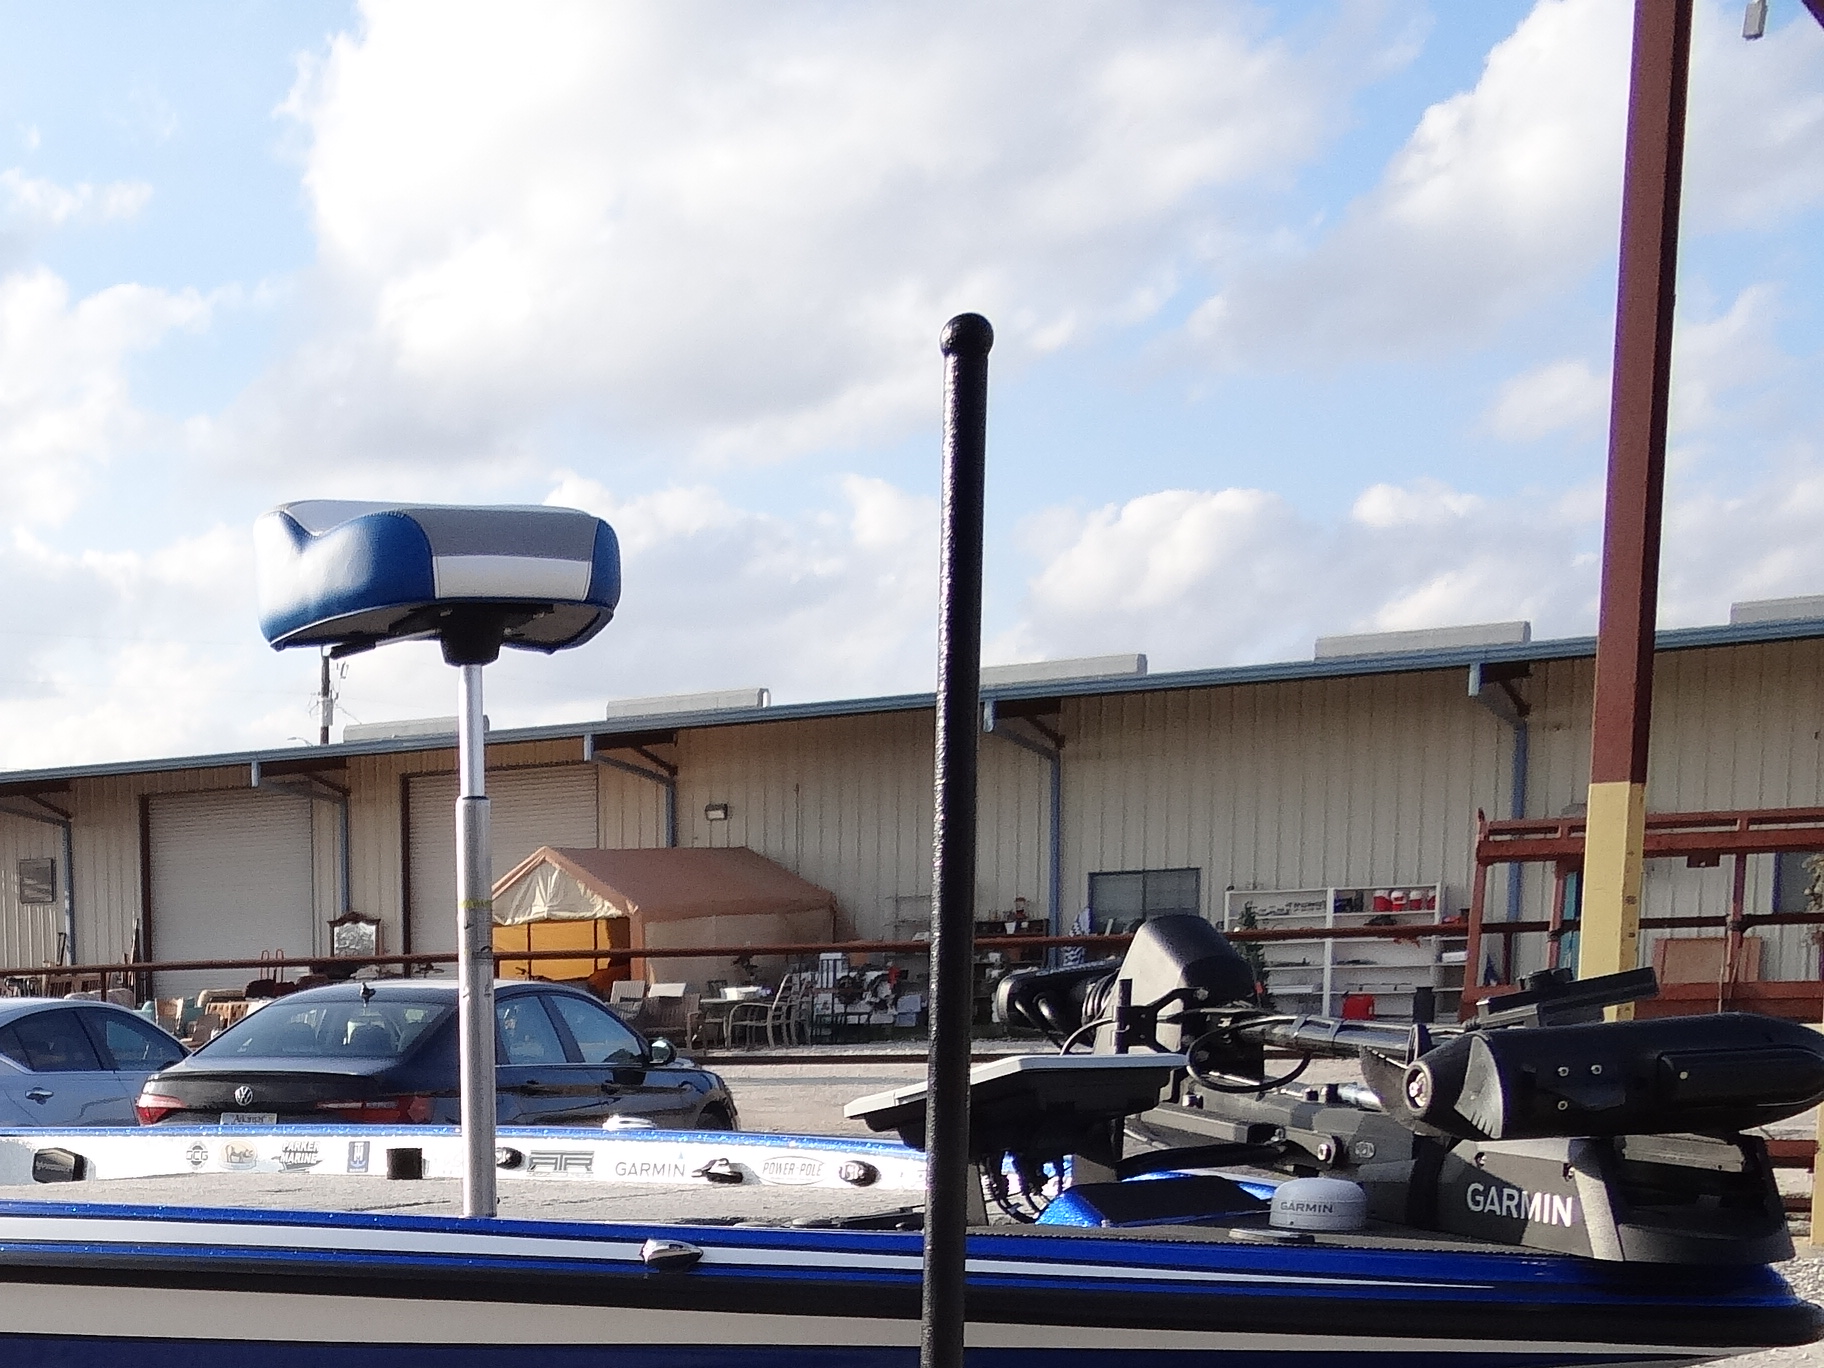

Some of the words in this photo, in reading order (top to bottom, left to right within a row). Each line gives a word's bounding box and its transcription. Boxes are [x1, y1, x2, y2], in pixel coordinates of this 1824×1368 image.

[281, 1140, 320, 1152] PARKER
[279, 1152, 318, 1164] MARINE
[615, 1161, 686, 1178] GARMIN
[761, 1162, 823, 1177] POWER-POLE
[1279, 1200, 1334, 1214] GARMIN
[1466, 1182, 1573, 1228] GARMIN
